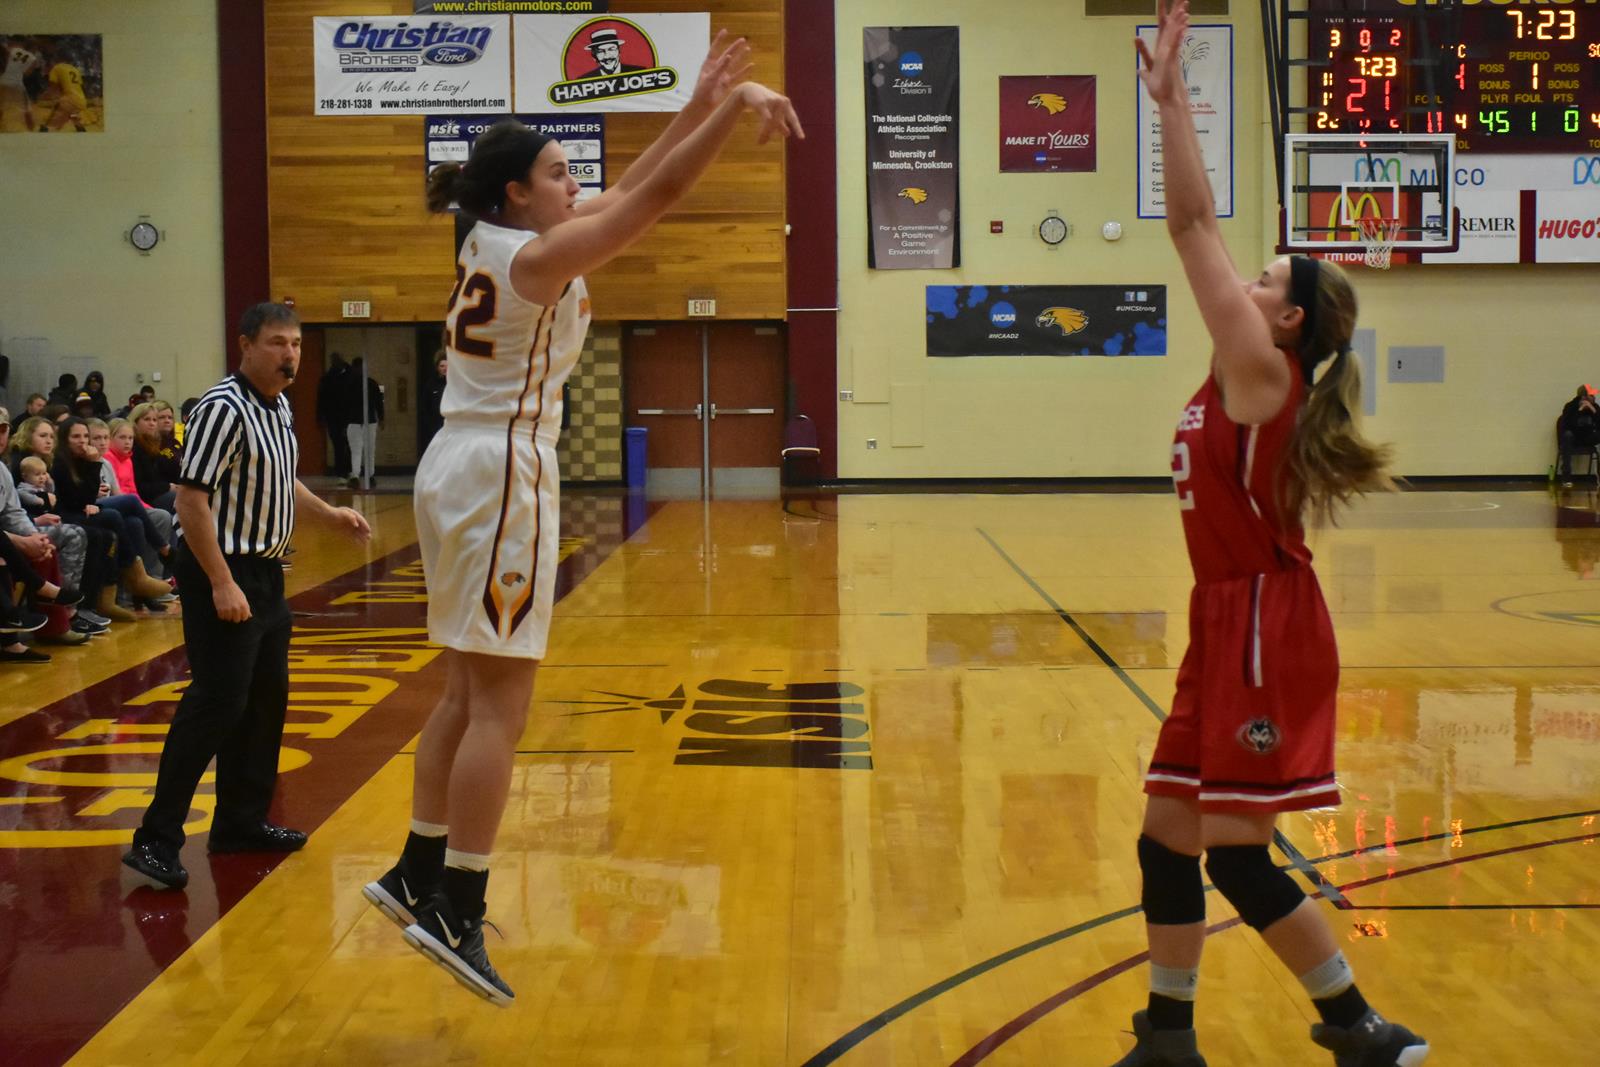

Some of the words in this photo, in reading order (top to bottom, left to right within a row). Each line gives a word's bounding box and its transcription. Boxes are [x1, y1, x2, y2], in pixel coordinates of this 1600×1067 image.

[433, 1, 592, 11] www.christianmotors.com
[1506, 10, 1576, 39] 7:23
[334, 22, 492, 51] Christian
[339, 53, 419, 65] BROTHERS
[434, 48, 468, 63] Ford
[1509, 51, 1550, 60] PERIOD
[1354, 57, 1397, 76] 7:23
[1480, 64, 1504, 73] POSS
[1554, 63, 1580, 73] POSS
[1532, 63, 1539, 90] 1
[355, 81, 373, 93] We
[378, 80, 410, 93] Make
[417, 81, 429, 92] It
[433, 80, 470, 96] Easy!
[554, 81, 618, 101] HAPPY
[619, 71, 672, 92] JOE'S
[1480, 80, 1511, 90] BONUS
[1548, 80, 1580, 89] BONUS
[900, 87, 927, 95] Division
[320, 99, 372, 109] 218-281-1338
[380, 98, 505, 109] www.christianbrothersford.com
[1481, 93, 1509, 103] PLYR
[1514, 94, 1543, 103] FOUL
[1553, 93, 1574, 102] PTS
[872, 115, 885, 123] The
[886, 115, 916, 123] National
[917, 114, 952, 123] Collegiate
[1455, 113, 1467, 130] 4
[1479, 110, 1510, 133] 45
[1531, 111, 1537, 132] 1
[1564, 110, 1579, 132] 0
[541, 124, 601, 133] PARTNERS
[906, 125, 947, 133] Association
[1005, 137, 1036, 145] MAKE
[1037, 137, 1047, 145] IT
[1048, 129, 1089, 149] YOURS
[889, 150, 926, 159] University
[928, 150, 936, 158] of
[873, 162, 913, 170] Minnesota,
[1410, 168, 1485, 187] MICO
[888, 248, 939, 256] Environment
[694, 301, 711, 314] EXIT
[992, 314, 1016, 322] NCAA
